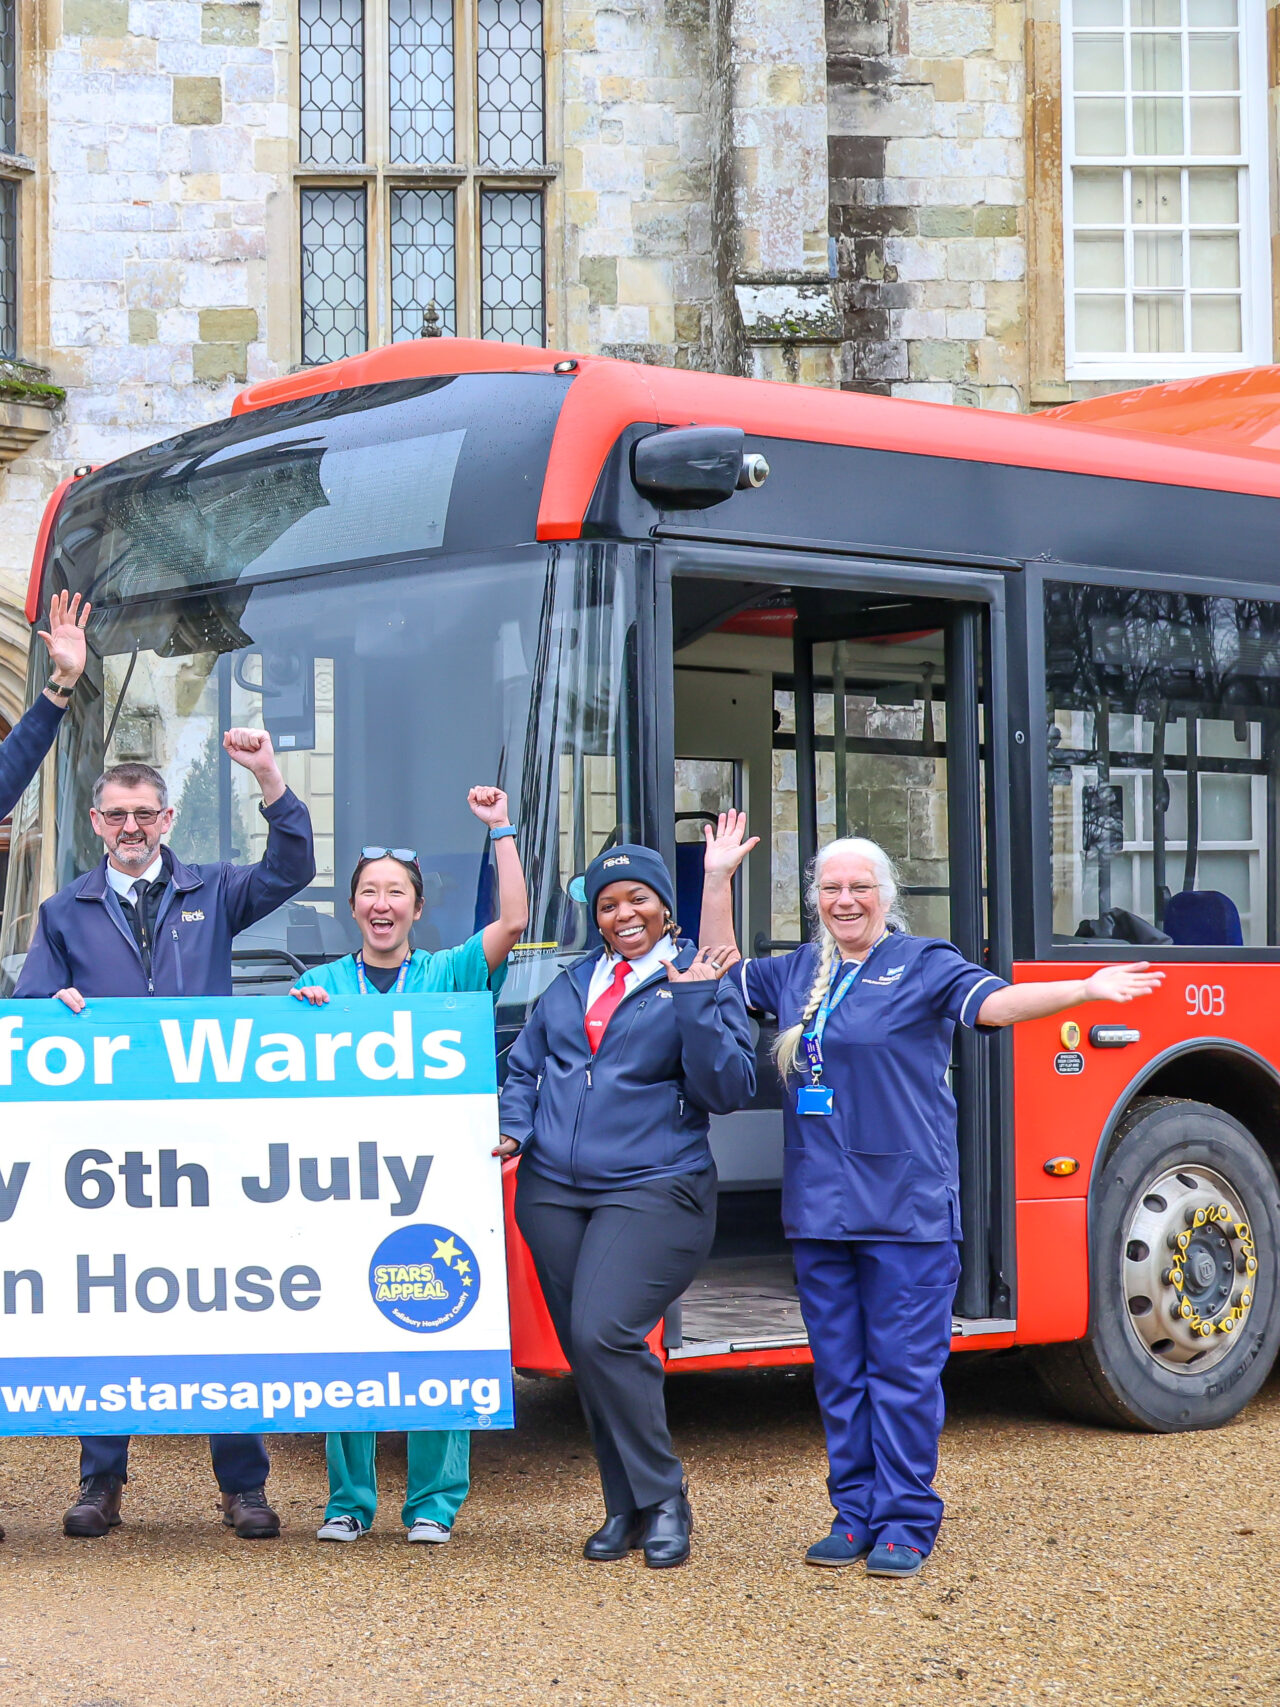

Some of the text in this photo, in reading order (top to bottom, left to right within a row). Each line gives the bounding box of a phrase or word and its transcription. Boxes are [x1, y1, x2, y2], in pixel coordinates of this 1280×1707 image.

[1185, 984, 1225, 1016] 903
[160, 1011, 466, 1083] Wards
[65, 1148, 210, 1209] 6th
[241, 1141, 434, 1216] July
[76, 1253, 322, 1314] House
[376, 1266, 433, 1283] STARS
[378, 1282, 447, 1299] APPEAL
[392, 1308, 421, 1328] Salisbury
[452, 1291, 469, 1314] Charity
